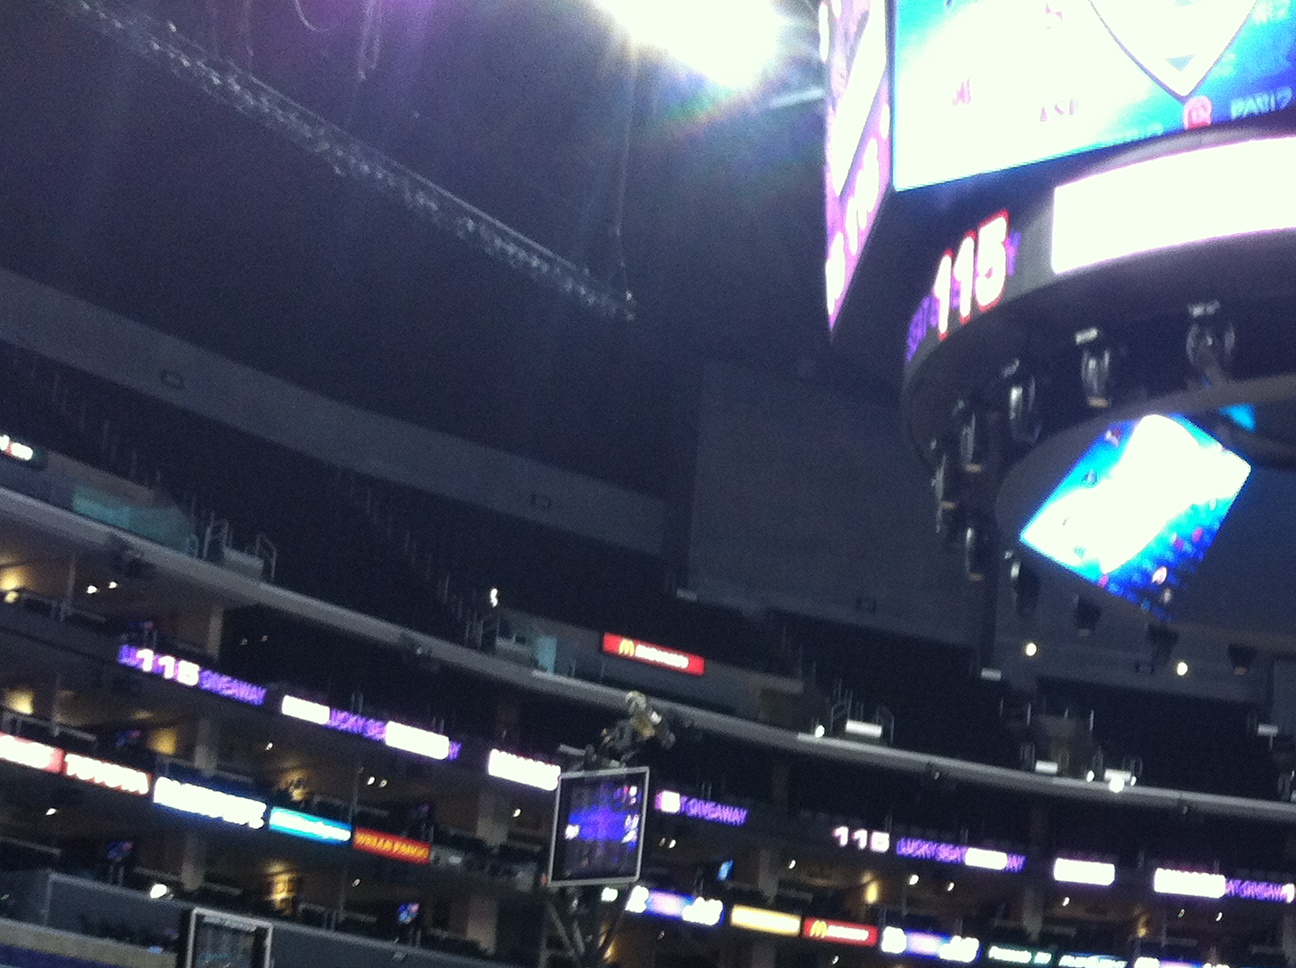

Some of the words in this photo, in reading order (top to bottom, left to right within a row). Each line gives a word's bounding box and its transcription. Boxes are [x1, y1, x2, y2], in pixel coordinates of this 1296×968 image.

[932, 208, 1010, 340] 115
[135, 648, 200, 686] 115
[834, 825, 890, 852] 115
